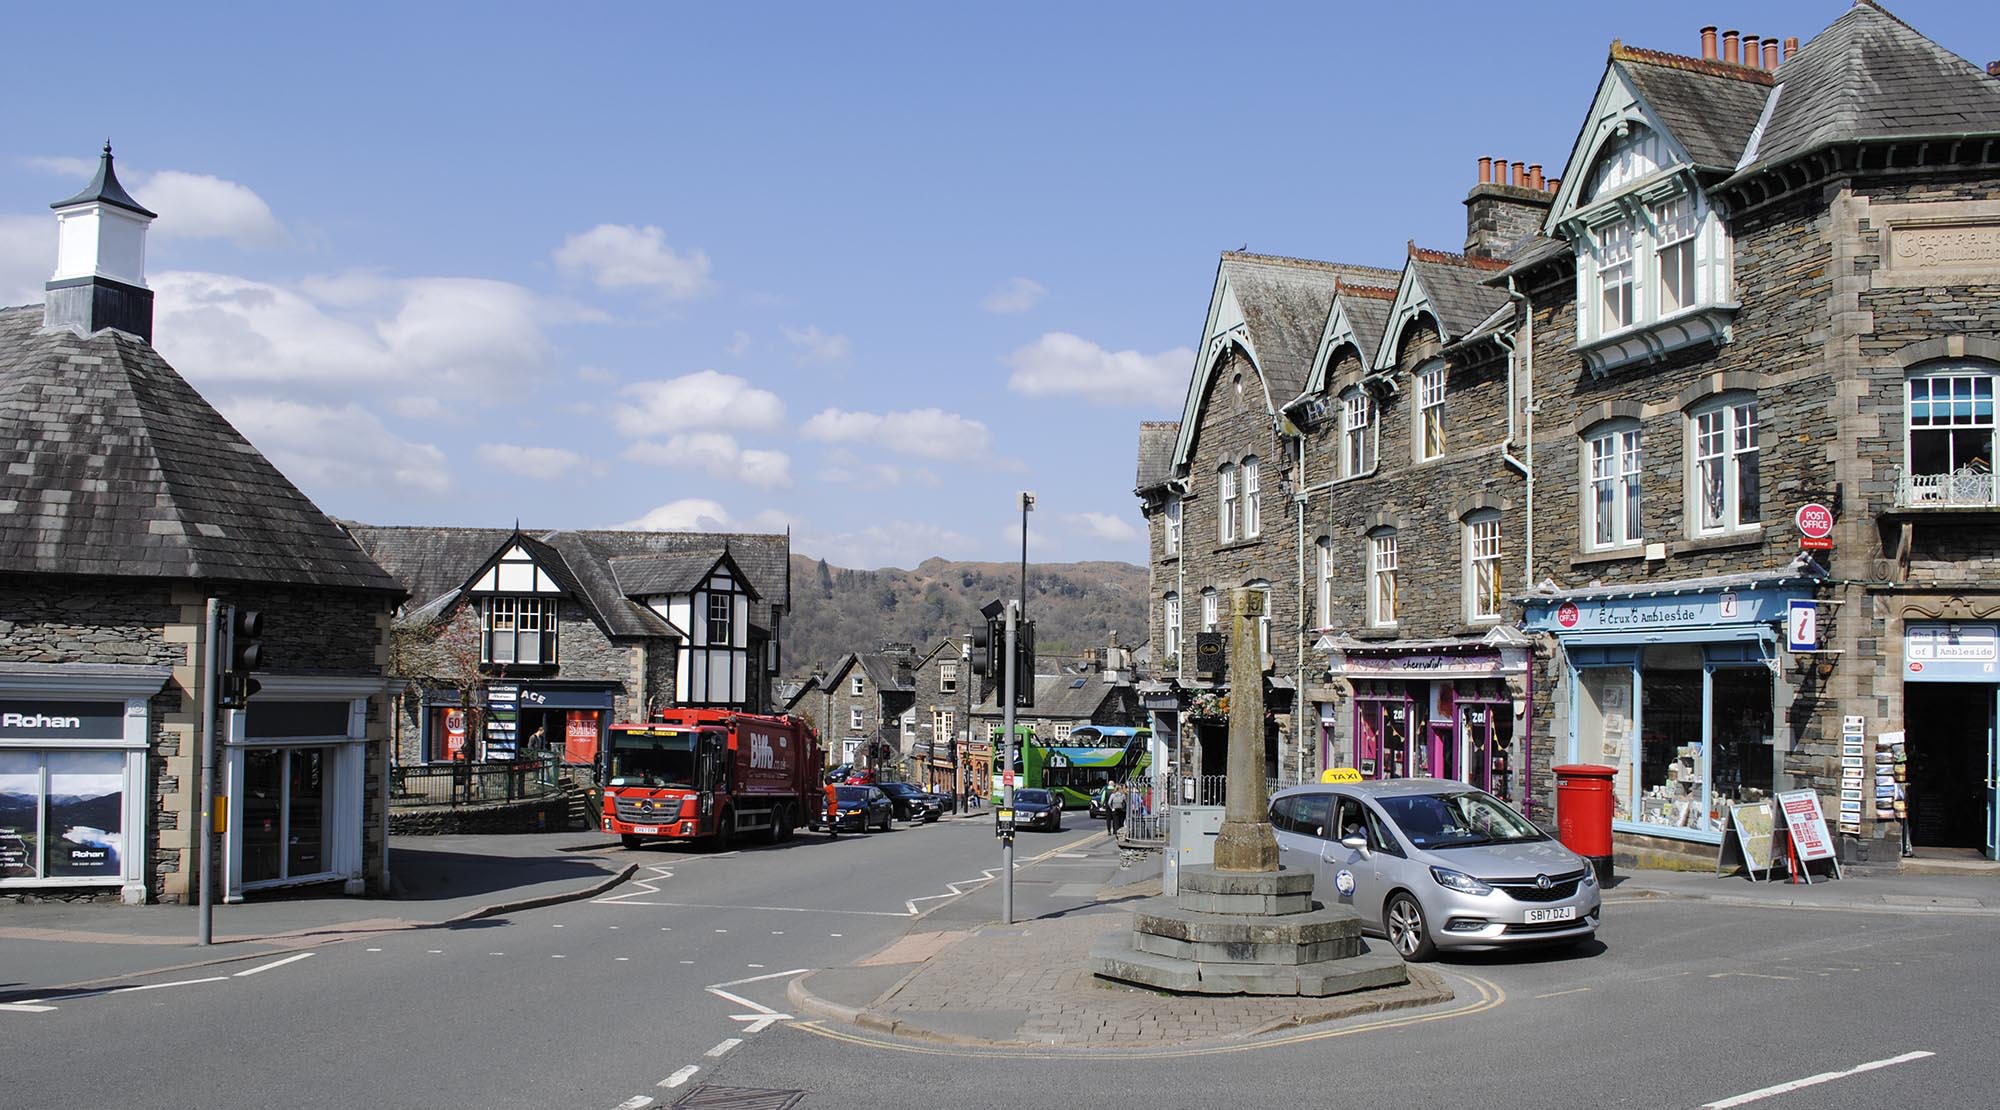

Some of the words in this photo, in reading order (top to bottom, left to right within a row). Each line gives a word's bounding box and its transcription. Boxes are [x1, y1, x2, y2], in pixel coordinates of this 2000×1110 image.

[1806, 511, 1825, 520] POST
[1802, 519, 1828, 529] OFFICE
[1560, 614, 1576, 622] OFFICE
[1608, 614, 1630, 624] Crux
[1641, 610, 1695, 623] Ambleside
[1912, 631, 1930, 640] The
[1915, 647, 1926, 656] of
[1940, 648, 1993, 656] Ambleside
[2, 712, 81, 729] Rohan
[568, 721, 597, 736] SALE
[750, 732, 774, 769] Biffa
[1330, 773, 1359, 781] TAXI
[72, 850, 105, 858] Rohan
[1530, 909, 1550, 920] SB17
[1553, 907, 1570, 918] DZJ
